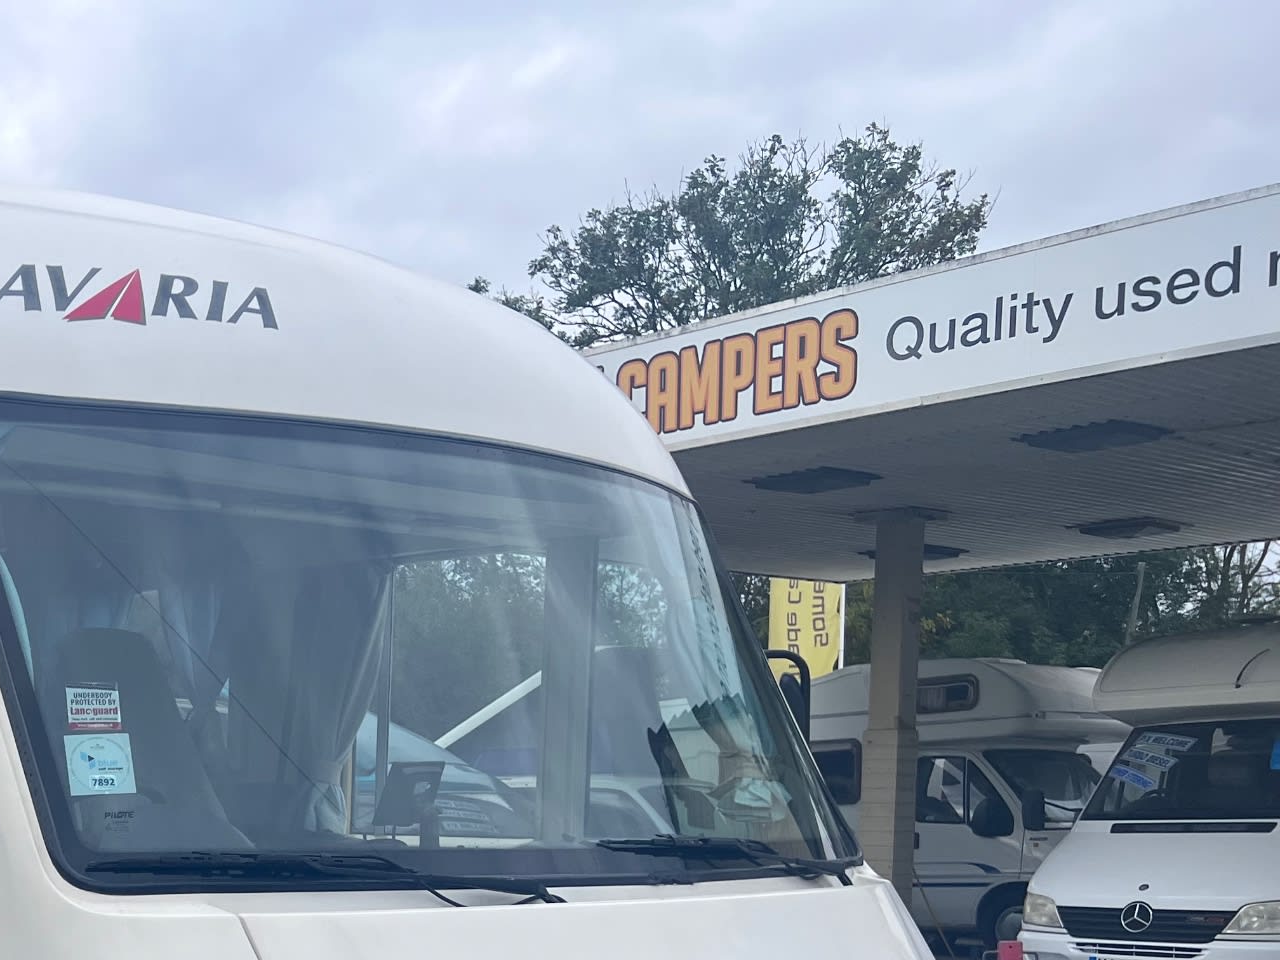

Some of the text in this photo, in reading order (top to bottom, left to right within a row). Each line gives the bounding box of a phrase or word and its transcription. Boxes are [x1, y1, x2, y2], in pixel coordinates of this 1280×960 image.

[616, 308, 859, 434] CAMPERS
[886, 288, 1074, 361] Quality
[1095, 245, 1242, 320] used
[91, 778, 115, 787] 7892
